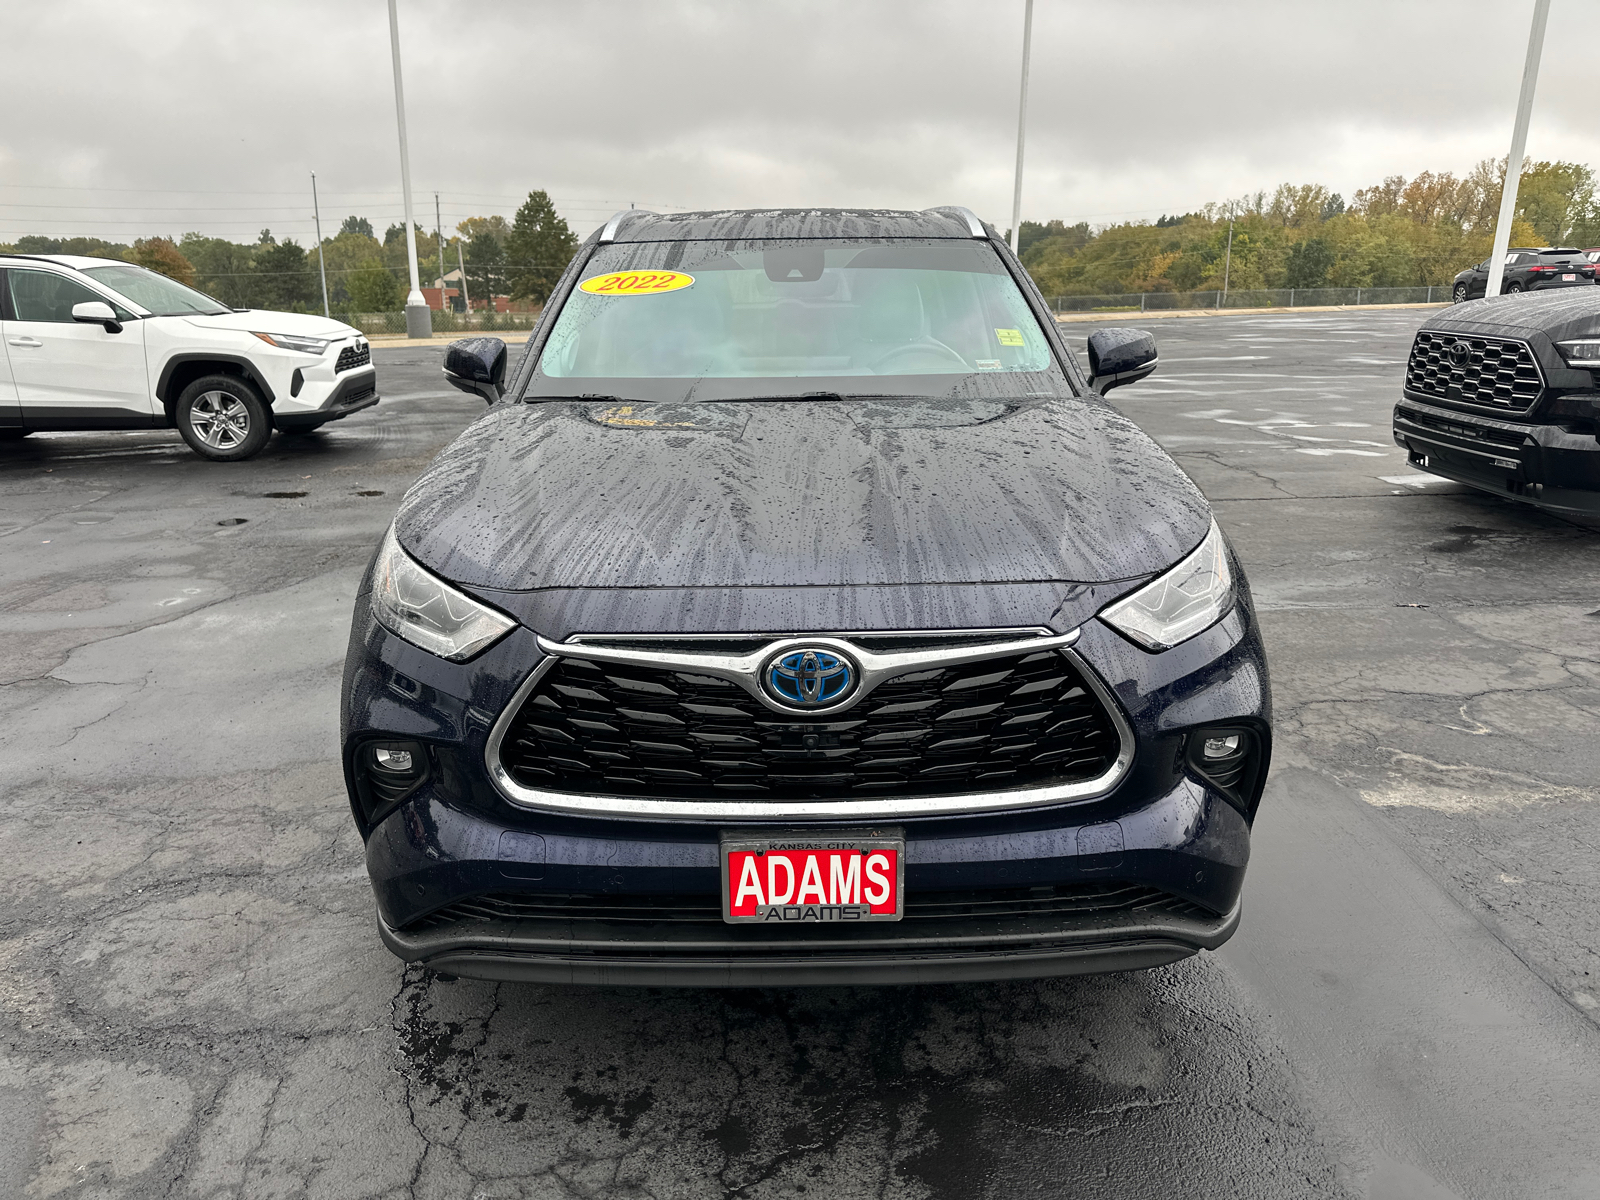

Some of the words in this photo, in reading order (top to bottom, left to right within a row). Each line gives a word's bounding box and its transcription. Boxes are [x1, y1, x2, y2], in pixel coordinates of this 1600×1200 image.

[596, 274, 677, 291] 2022
[827, 842, 856, 850] CITY
[734, 854, 891, 907] ADAMS
[764, 906, 861, 921] ADAMS
